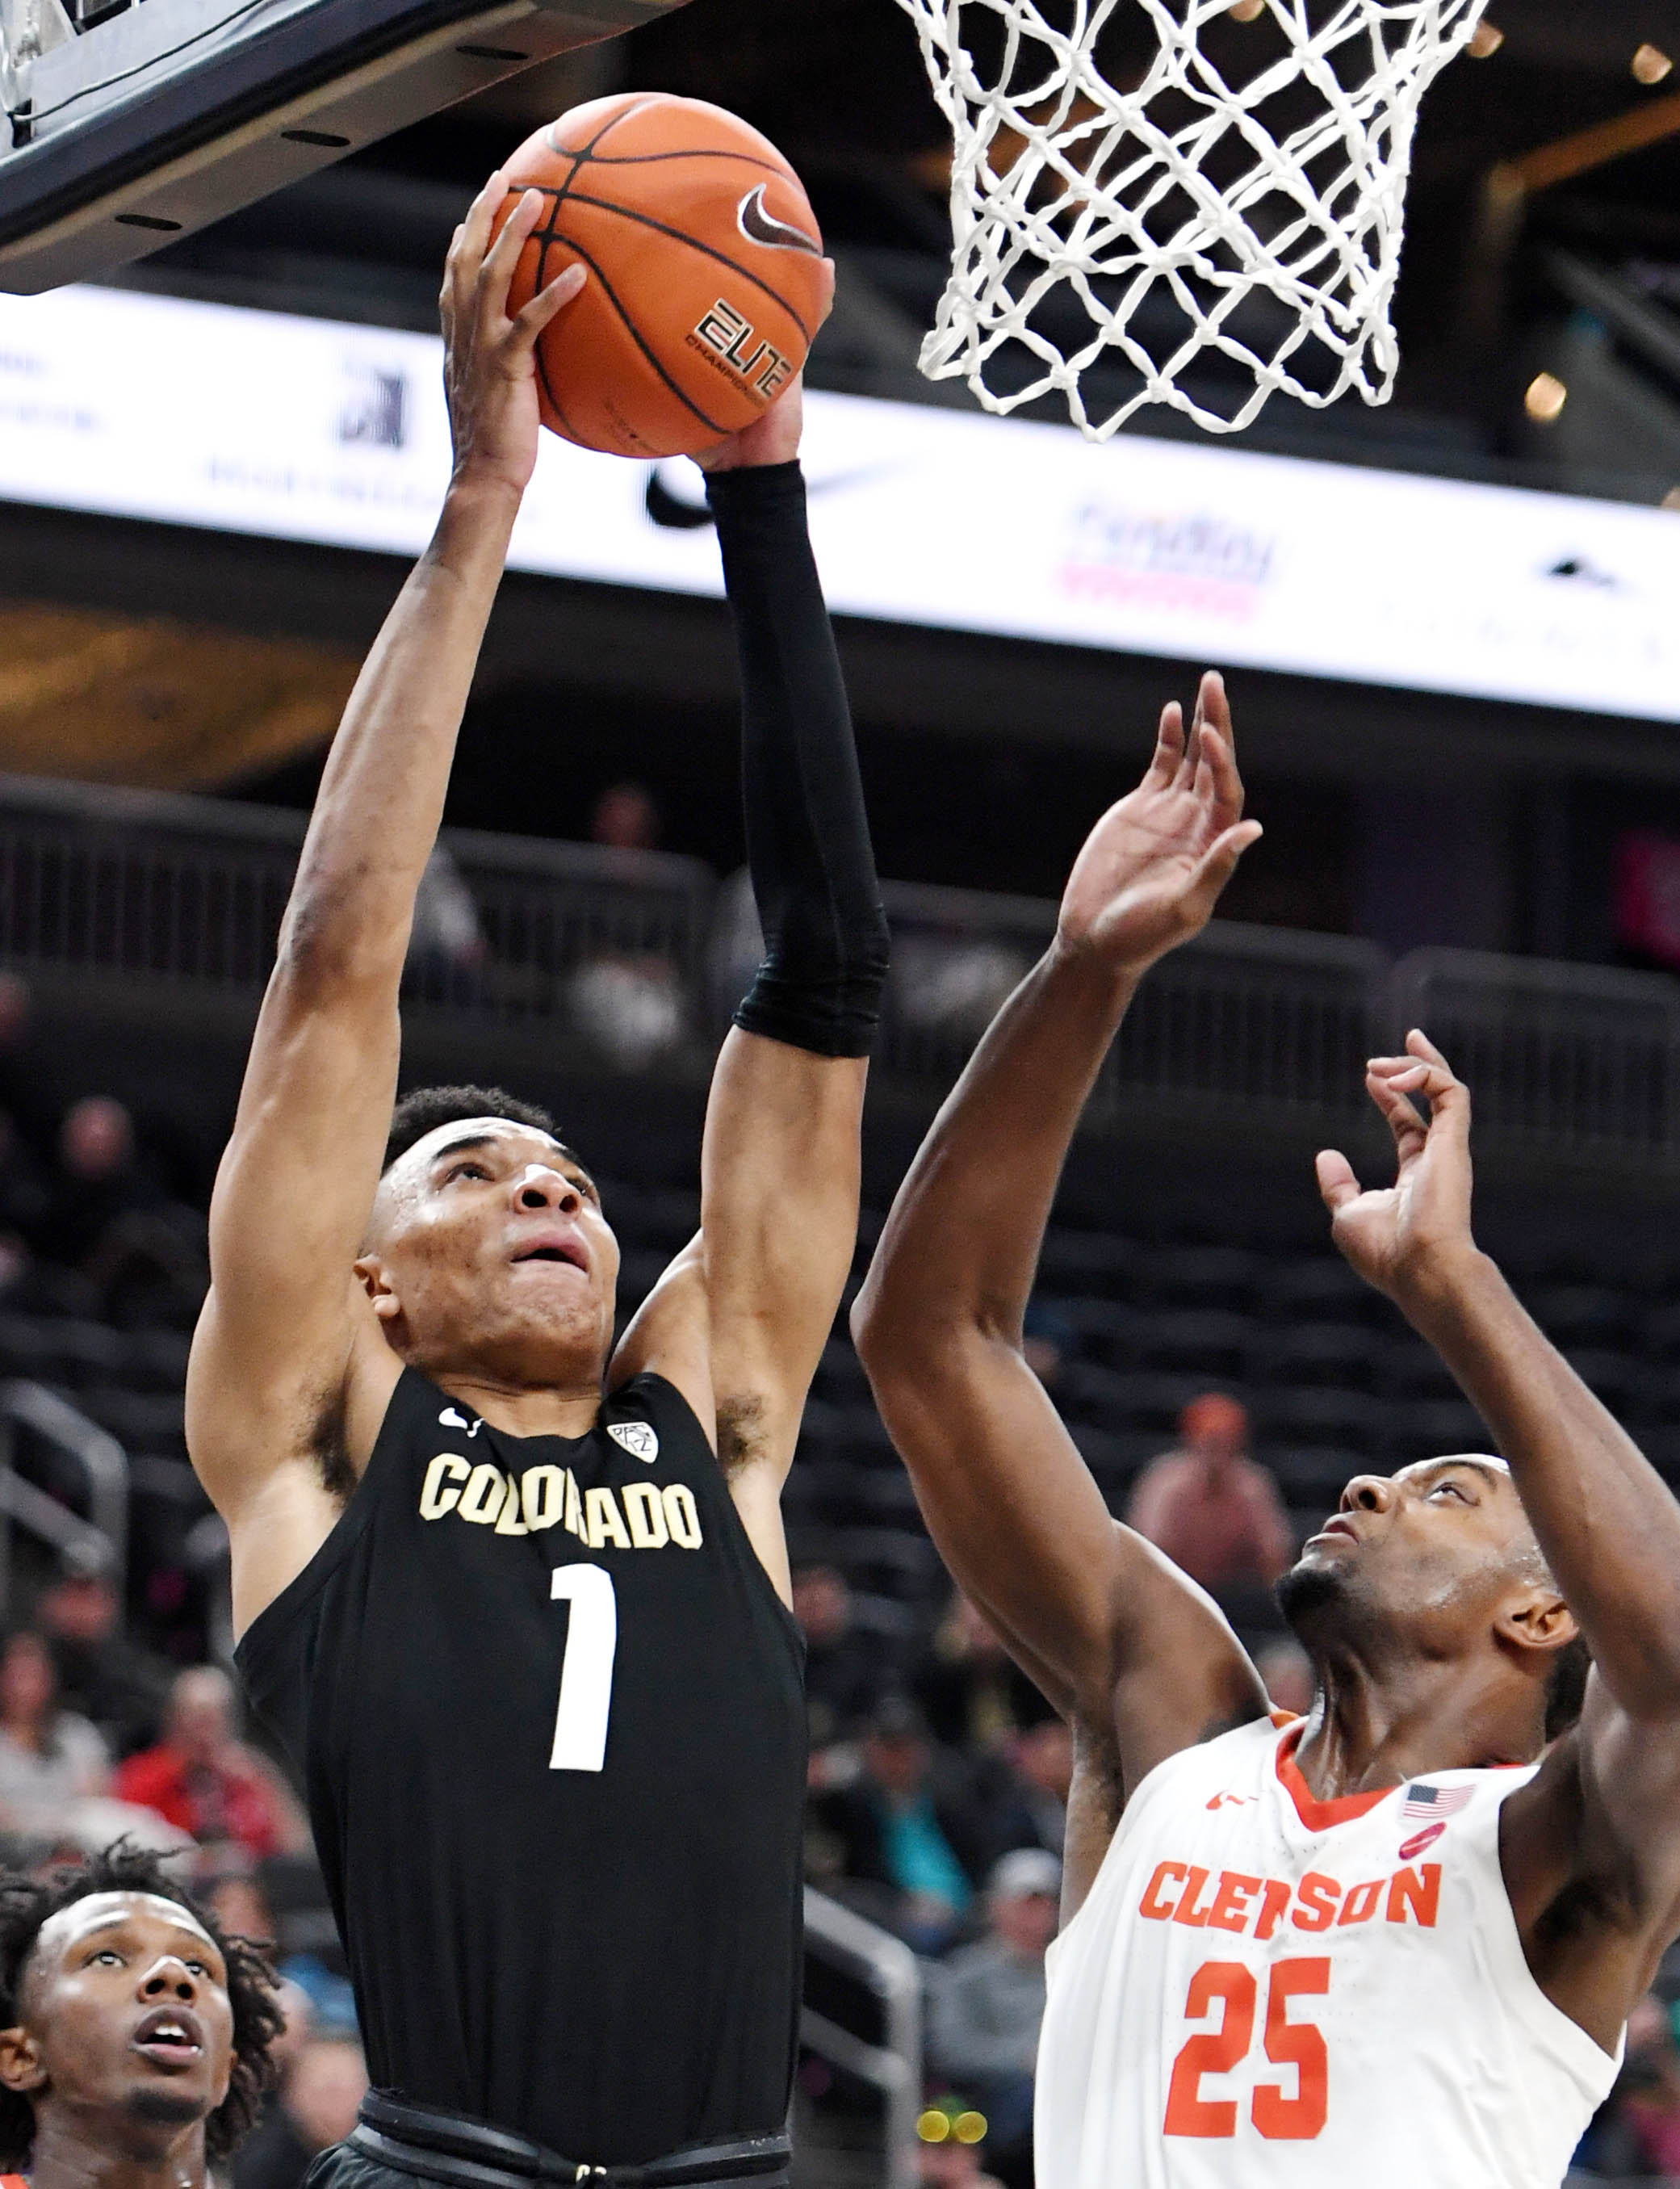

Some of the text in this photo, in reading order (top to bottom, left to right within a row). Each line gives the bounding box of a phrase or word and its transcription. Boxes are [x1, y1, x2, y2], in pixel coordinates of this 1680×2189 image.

[694, 298, 792, 400] ELITE
[419, 1453, 703, 1549] COLORADO
[549, 1562, 616, 1772] 1
[1163, 1956, 1330, 2139] 25
